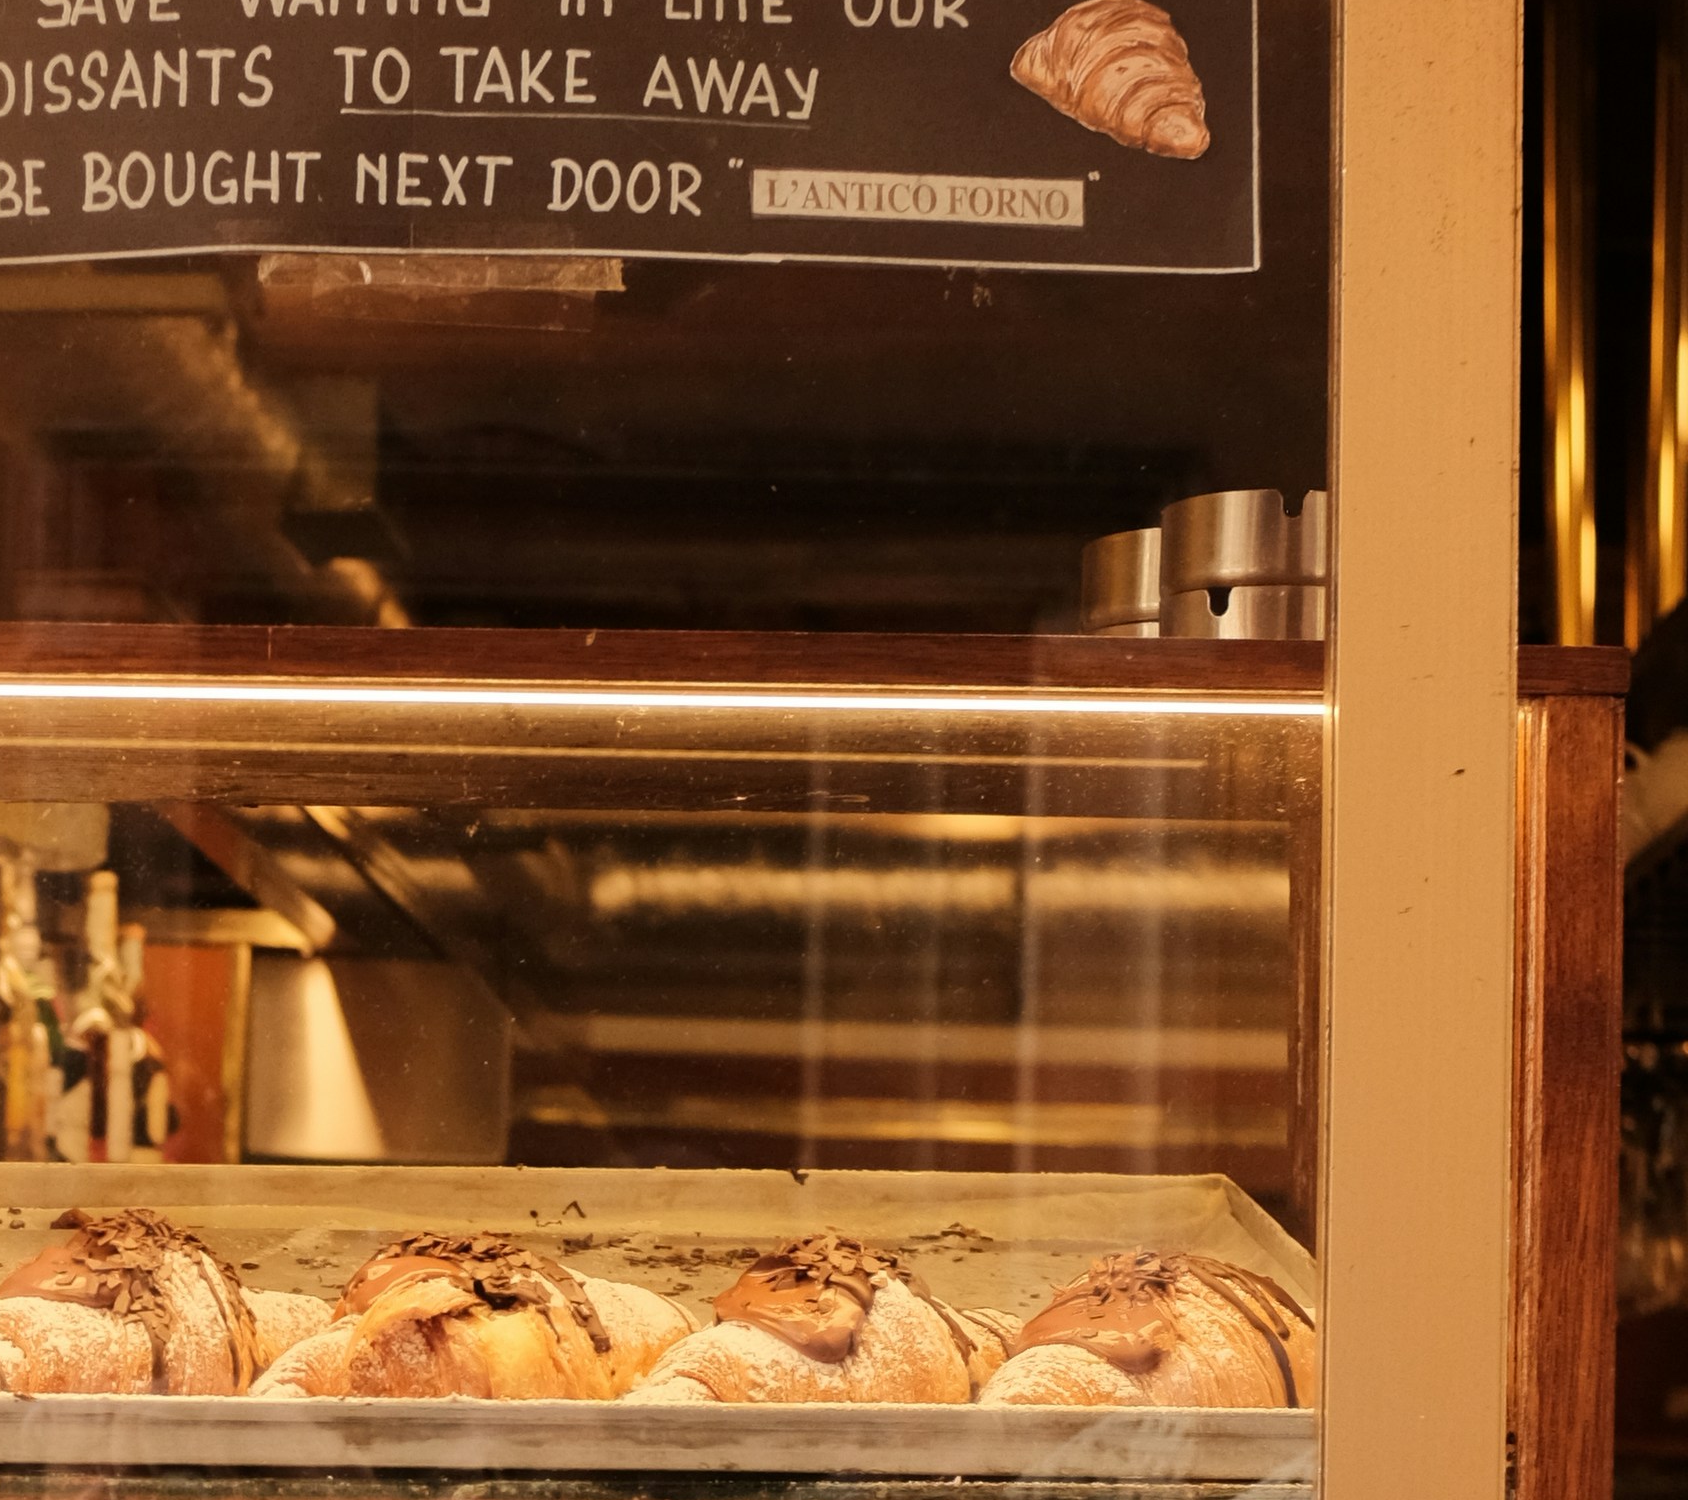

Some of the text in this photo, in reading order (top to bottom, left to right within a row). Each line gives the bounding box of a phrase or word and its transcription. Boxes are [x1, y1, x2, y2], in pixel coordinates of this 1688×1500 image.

[333, 46, 411, 105] TO
[439, 45, 597, 104] TAKE
[642, 54, 819, 120] AWAY
[81, 149, 322, 213] BOUGHT
[355, 151, 514, 207] NEXT
[546, 157, 702, 217] DOOR
